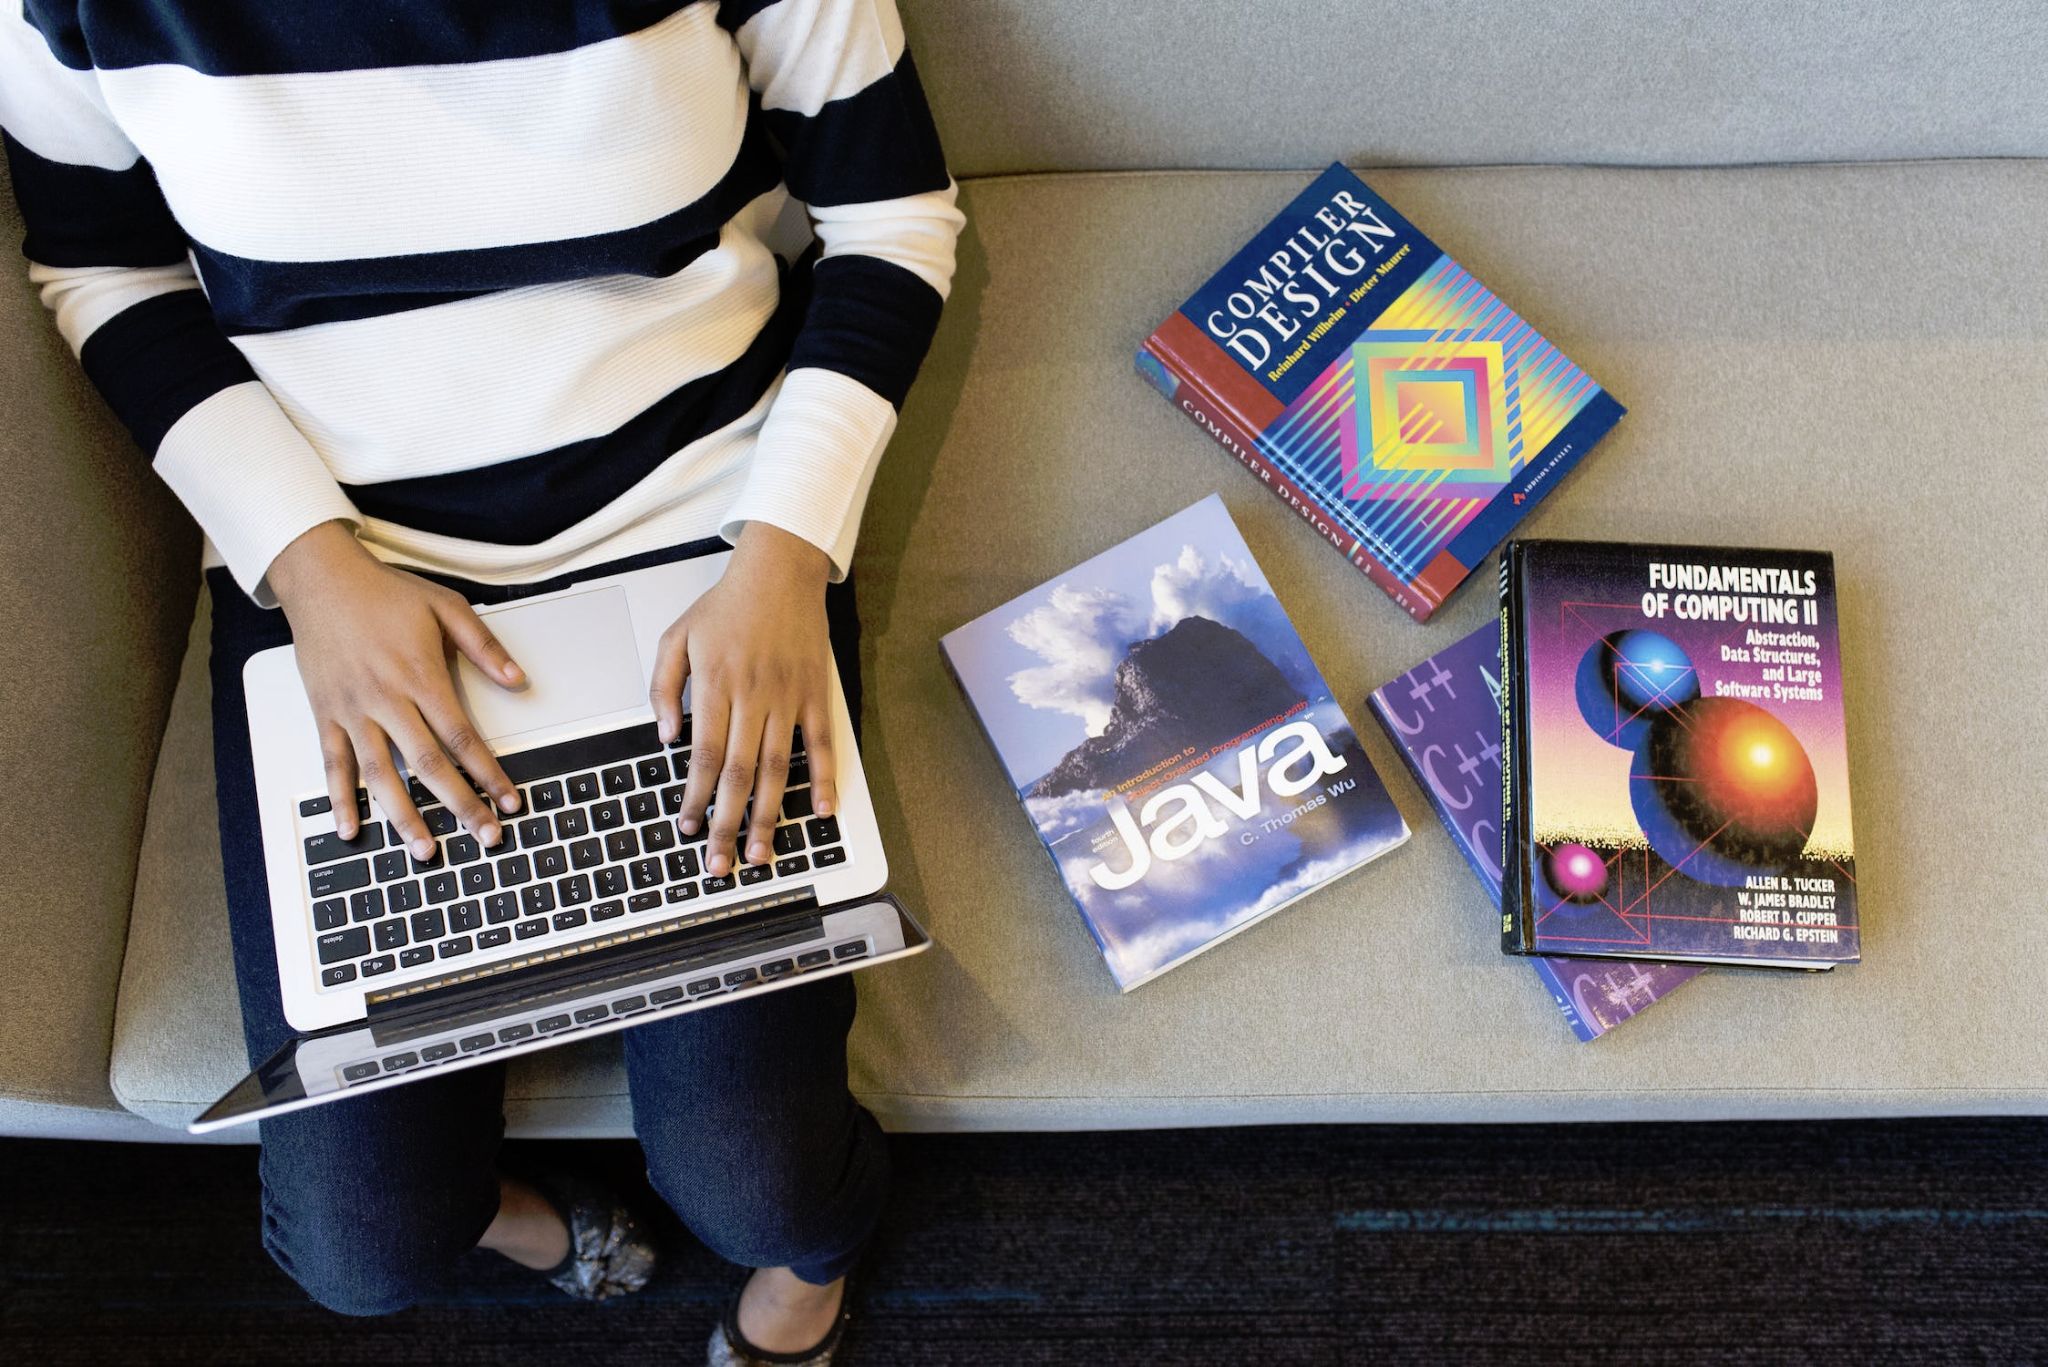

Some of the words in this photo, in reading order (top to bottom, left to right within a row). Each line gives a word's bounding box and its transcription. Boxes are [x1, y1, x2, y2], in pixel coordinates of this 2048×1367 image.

[1207, 190, 1366, 338] COMPILER
[1226, 206, 1396, 371] DESIGN
[1267, 341, 1312, 382] Reinhard
[1307, 306, 1346, 343] Wilhelm
[1349, 274, 1379, 303] Dieter
[1375, 243, 1411, 277] Maurer
[1182, 400, 1272, 482] COMPILER
[1277, 485, 1344, 548] DESIGN
[1649, 562, 1817, 596] FUNDAMENTALS
[1641, 592, 1669, 619] OF
[1674, 594, 1799, 625] COMPUTING
[1803, 599, 1818, 625] II
[1745, 629, 1820, 649] Abstraction,
[1721, 644, 1750, 662] Data
[1752, 646, 1821, 667] Structures,
[1762, 666, 1786, 682] and
[1787, 667, 1822, 687] Large
[1715, 680, 1771, 699] Software
[1773, 683, 1823, 703] Systems
[1505, 709, 1511, 725] OF
[1211, 714, 1285, 756] Programming
[1286, 700, 1308, 718] with
[650, 767, 657, 776] C
[1117, 754, 1182, 793] Introduction
[1183, 746, 1196, 757] to
[615, 775, 623, 784] V
[579, 783, 587, 792] B
[543, 791, 552, 801] N
[673, 793, 682, 803] D
[640, 802, 646, 812] F
[1088, 720, 1348, 891] Java
[602, 810, 611, 820] G
[1240, 832, 1260, 846] C.
[1260, 794, 1327, 834] Thomas
[1327, 778, 1357, 798] Wu
[567, 818, 576, 828] H
[532, 826, 538, 836] J
[654, 831, 661, 841] R
[310, 837, 325, 847] shift
[619, 840, 626, 850] T
[459, 843, 466, 852] L
[583, 848, 590, 858] Y
[546, 856, 555, 867] U
[678, 855, 684, 863] 4
[512, 865, 516, 874] I
[641, 863, 648, 872] 5
[314, 869, 334, 878] return
[473, 873, 482, 883] O
[605, 871, 612, 881] 6
[642, 873, 652, 882] %
[437, 882, 445, 892] P
[571, 879, 577, 889] 7
[1745, 875, 1779, 891] ALLEN
[1781, 876, 1792, 891] B.
[1795, 877, 1836, 893] TUCKER
[533, 888, 540, 898] 8
[571, 890, 579, 899] &
[497, 897, 504, 906] 9
[1737, 892, 1752, 906] W.
[1754, 892, 1786, 909] JAMES
[1788, 894, 1836, 910] BRADLEY
[460, 906, 467, 915] 0
[1739, 909, 1780, 924] ROBERT
[1782, 909, 1794, 925] D.
[1796, 912, 1837, 927] CUPPER
[323, 935, 344, 944] delete
[1733, 925, 1780, 941] RICHARD
[1783, 927, 1794, 941] G.
[1796, 928, 1838, 944] EPSTEIN
